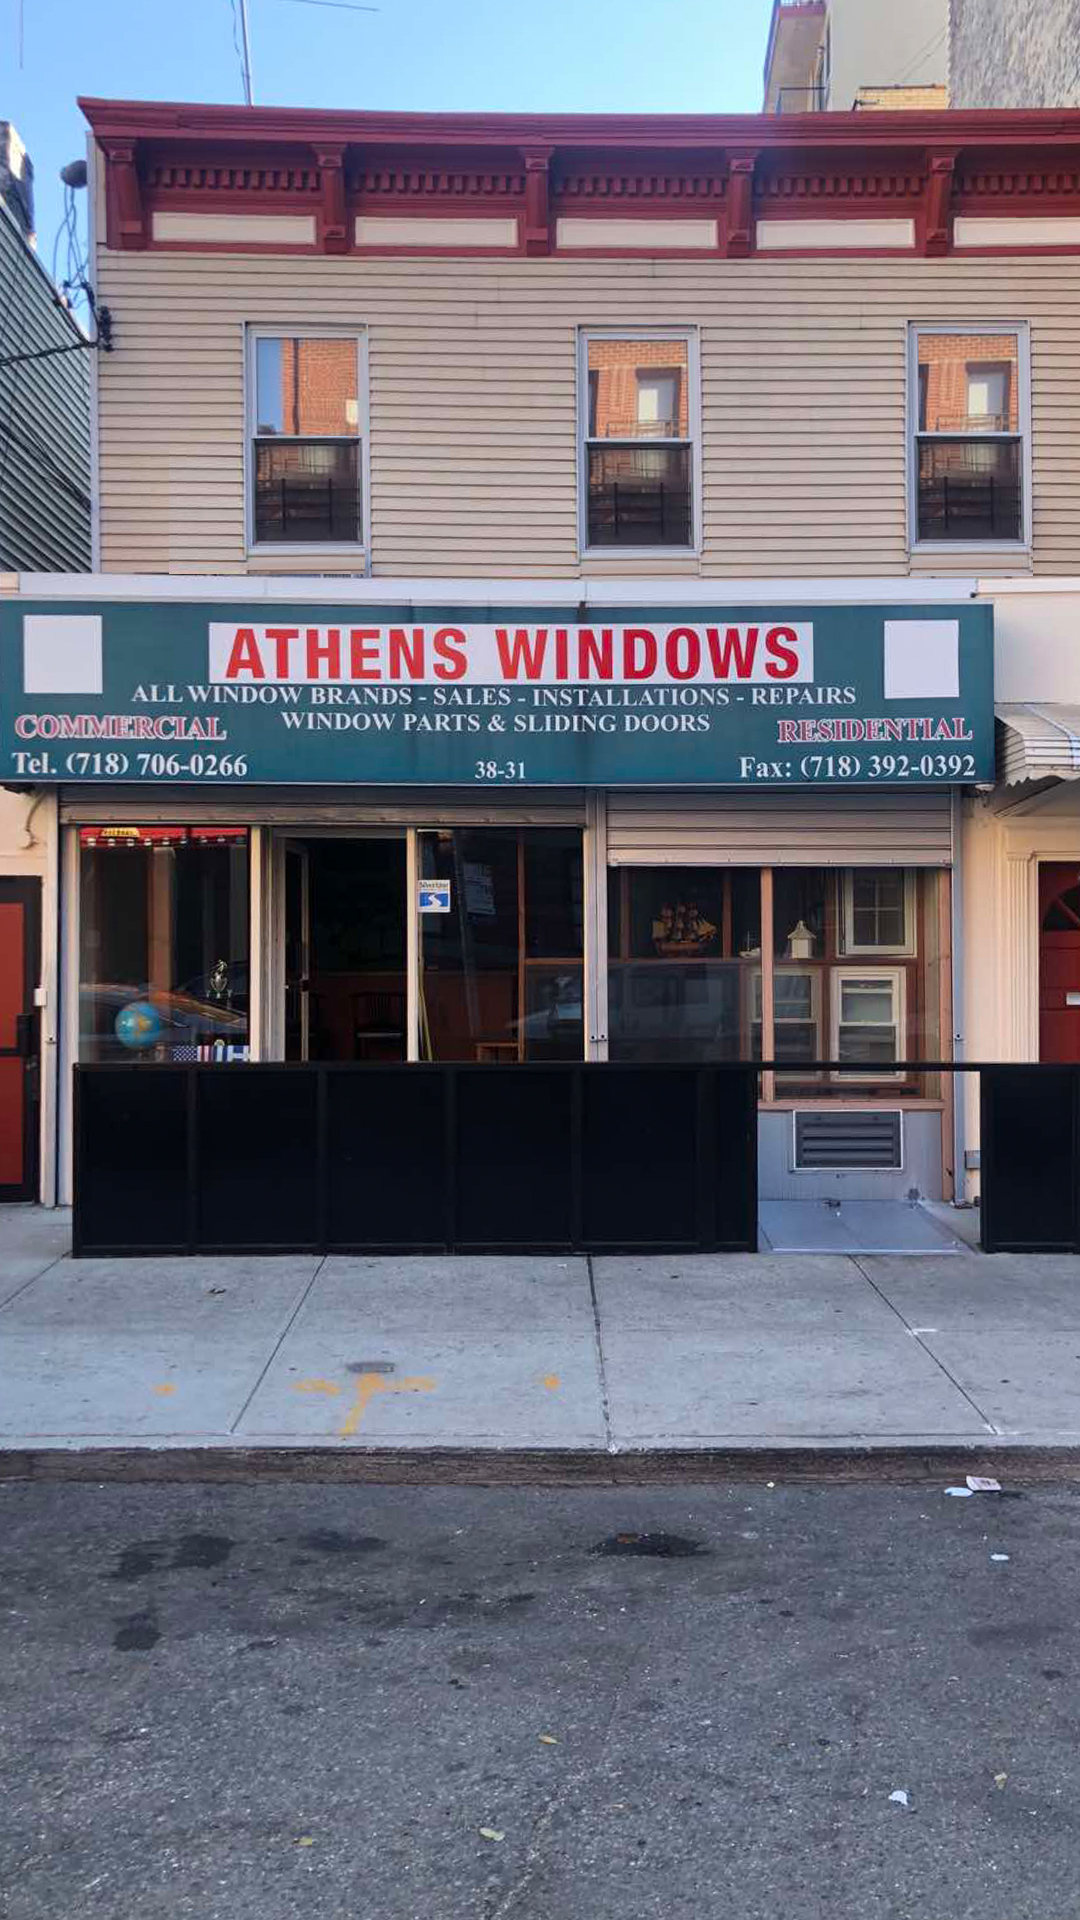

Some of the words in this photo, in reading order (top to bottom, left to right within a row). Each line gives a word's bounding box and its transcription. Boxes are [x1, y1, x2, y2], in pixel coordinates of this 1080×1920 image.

[226, 626, 468, 681] ATHENS
[496, 626, 800, 681] WINDOWS
[132, 684, 183, 703] ALL
[187, 685, 303, 704] WINDOW
[311, 687, 412, 706] BRANDS
[434, 687, 510, 707] SALES
[533, 688, 730, 707] INSTALLATIONS
[751, 687, 856, 705] REPAIRS
[14, 714, 227, 741] COMMERCIAL
[281, 711, 395, 731] WINDOW
[403, 713, 480, 732] PARTS
[488, 714, 505, 732] &
[514, 714, 616, 733] SLIDING
[624, 714, 710, 732] DOORS
[777, 718, 973, 743] RESIDENTIAL
[12, 752, 57, 775] Tel.
[66, 753, 129, 777] (718)
[136, 754, 248, 777] 706-0266
[474, 760, 526, 779] 38-31
[740, 756, 792, 778] Fax:
[800, 754, 861, 779] (718)
[868, 755, 976, 778] 392-0392
